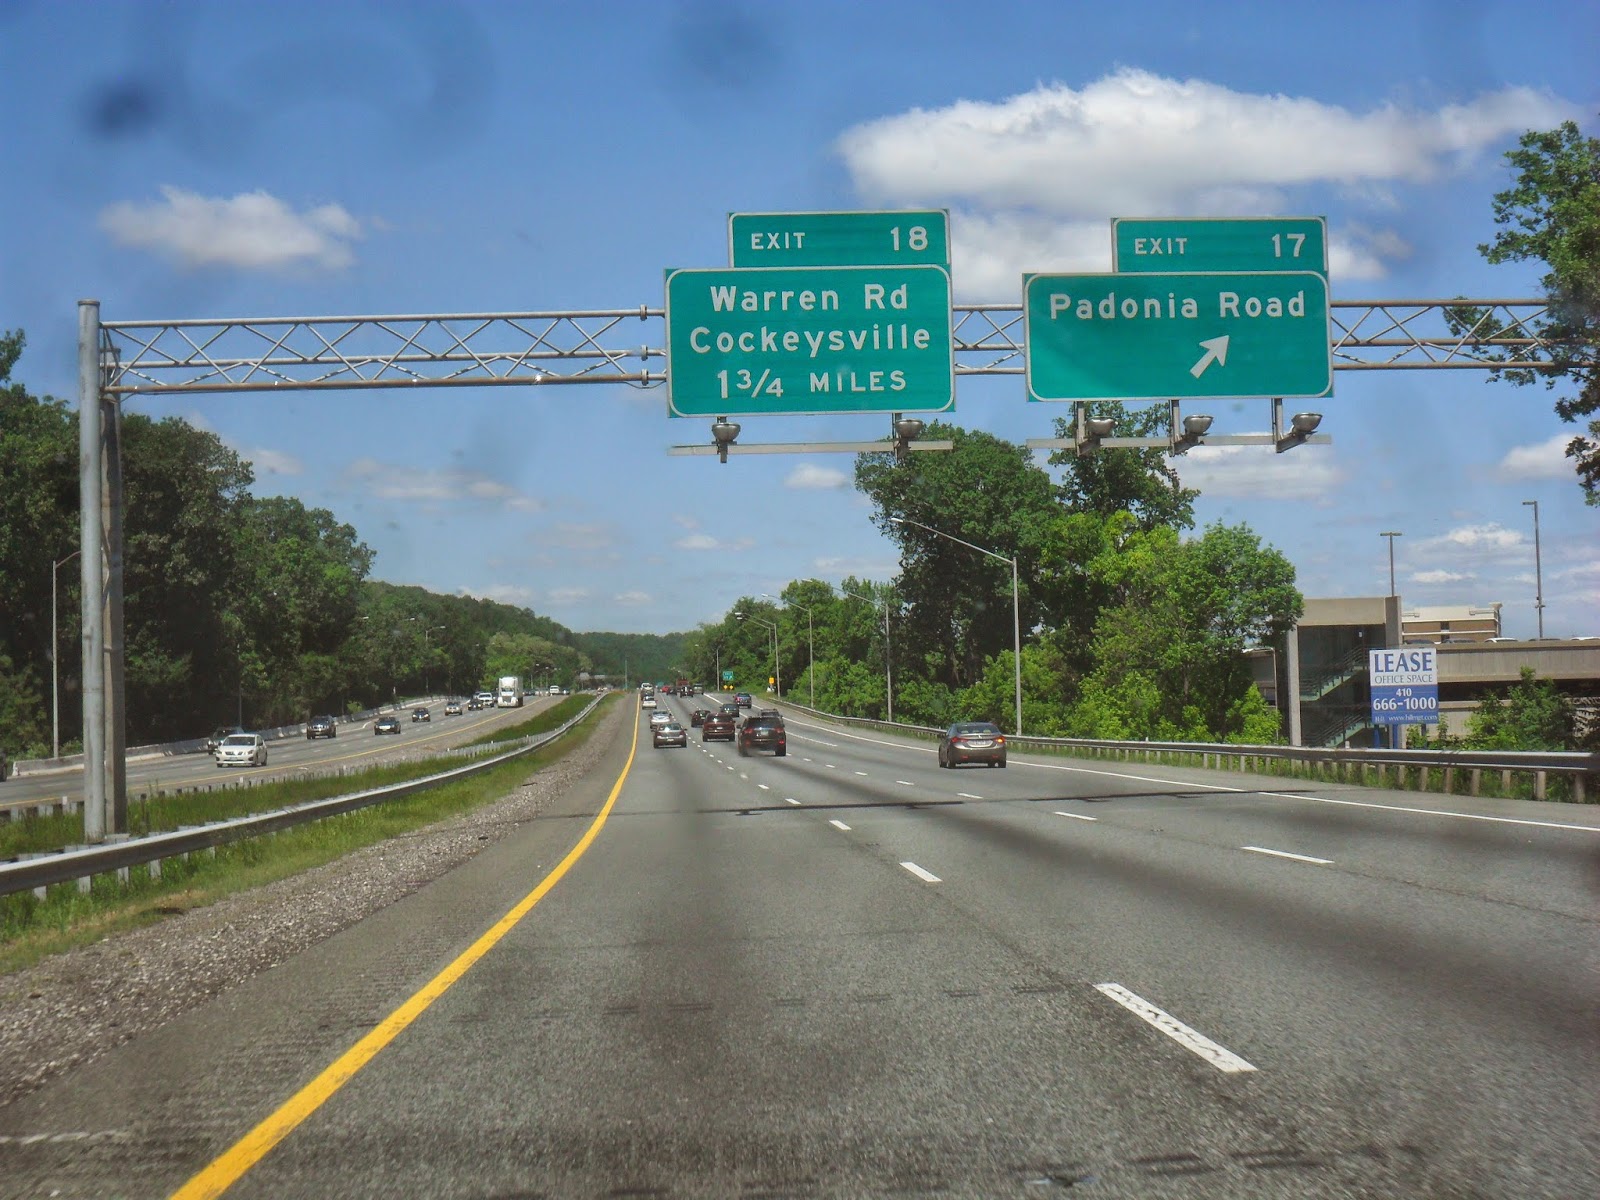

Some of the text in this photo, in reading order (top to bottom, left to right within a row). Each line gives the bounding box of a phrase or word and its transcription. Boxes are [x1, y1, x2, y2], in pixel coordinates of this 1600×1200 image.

[751, 232, 806, 250] EXIT
[890, 226, 928, 251] 18
[1134, 237, 1187, 255] EXIT
[1271, 233, 1306, 258] 17
[710, 283, 908, 312] Warren Rd
[1049, 290, 1306, 320] Padonia Road
[689, 323, 930, 358] Cockeysville
[810, 370, 906, 393] MILES
[1375, 652, 1432, 672] LEASE
[1374, 674, 1433, 684] OFFICE SPACE
[1396, 688, 1412, 697] 410
[1373, 697, 1436, 711] 666-1000
